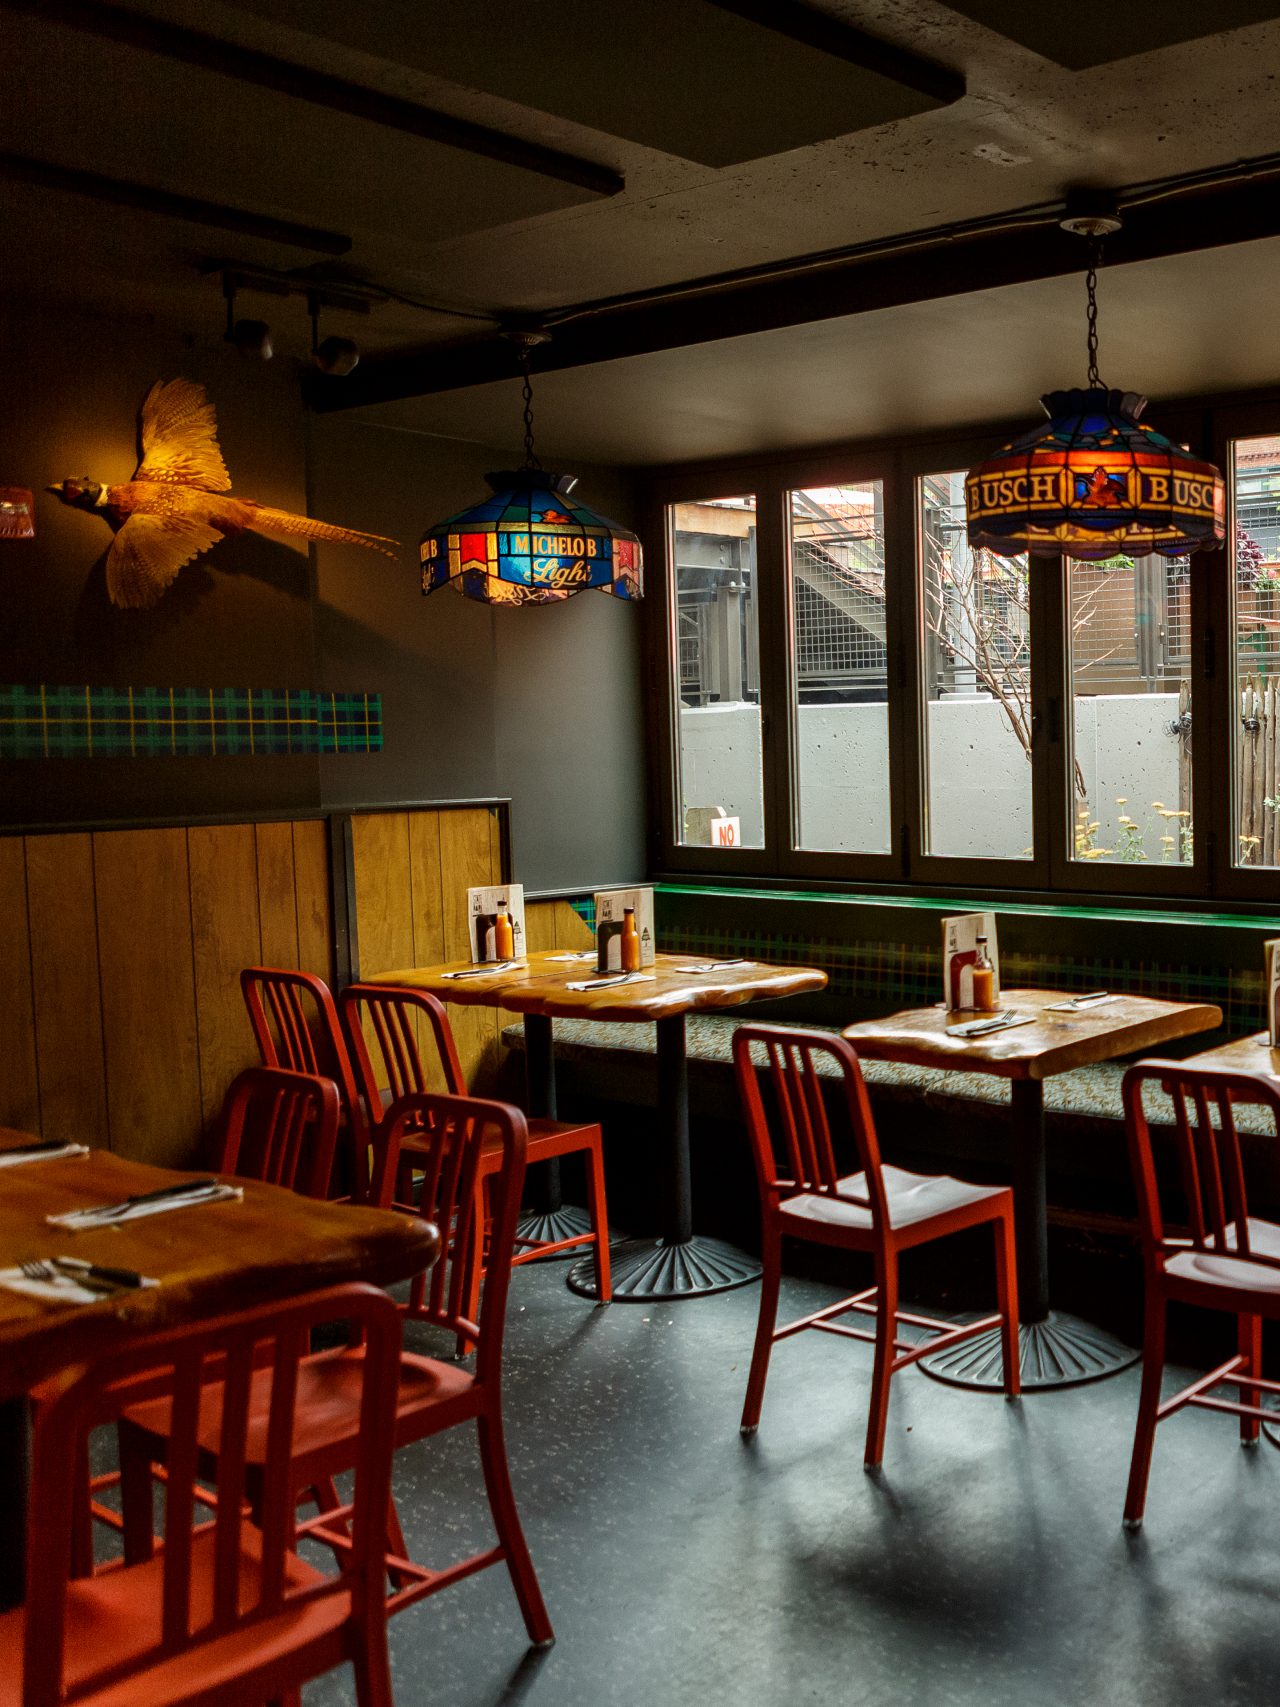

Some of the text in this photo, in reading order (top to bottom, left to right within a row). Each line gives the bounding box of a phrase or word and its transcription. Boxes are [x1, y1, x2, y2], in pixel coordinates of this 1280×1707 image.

[971, 475, 1056, 511] BUSCH
[1149, 476, 1214, 509] BUSC
[515, 535, 597, 557] MICHELOB
[523, 558, 593, 588] Light
[719, 824, 734, 846] NO
